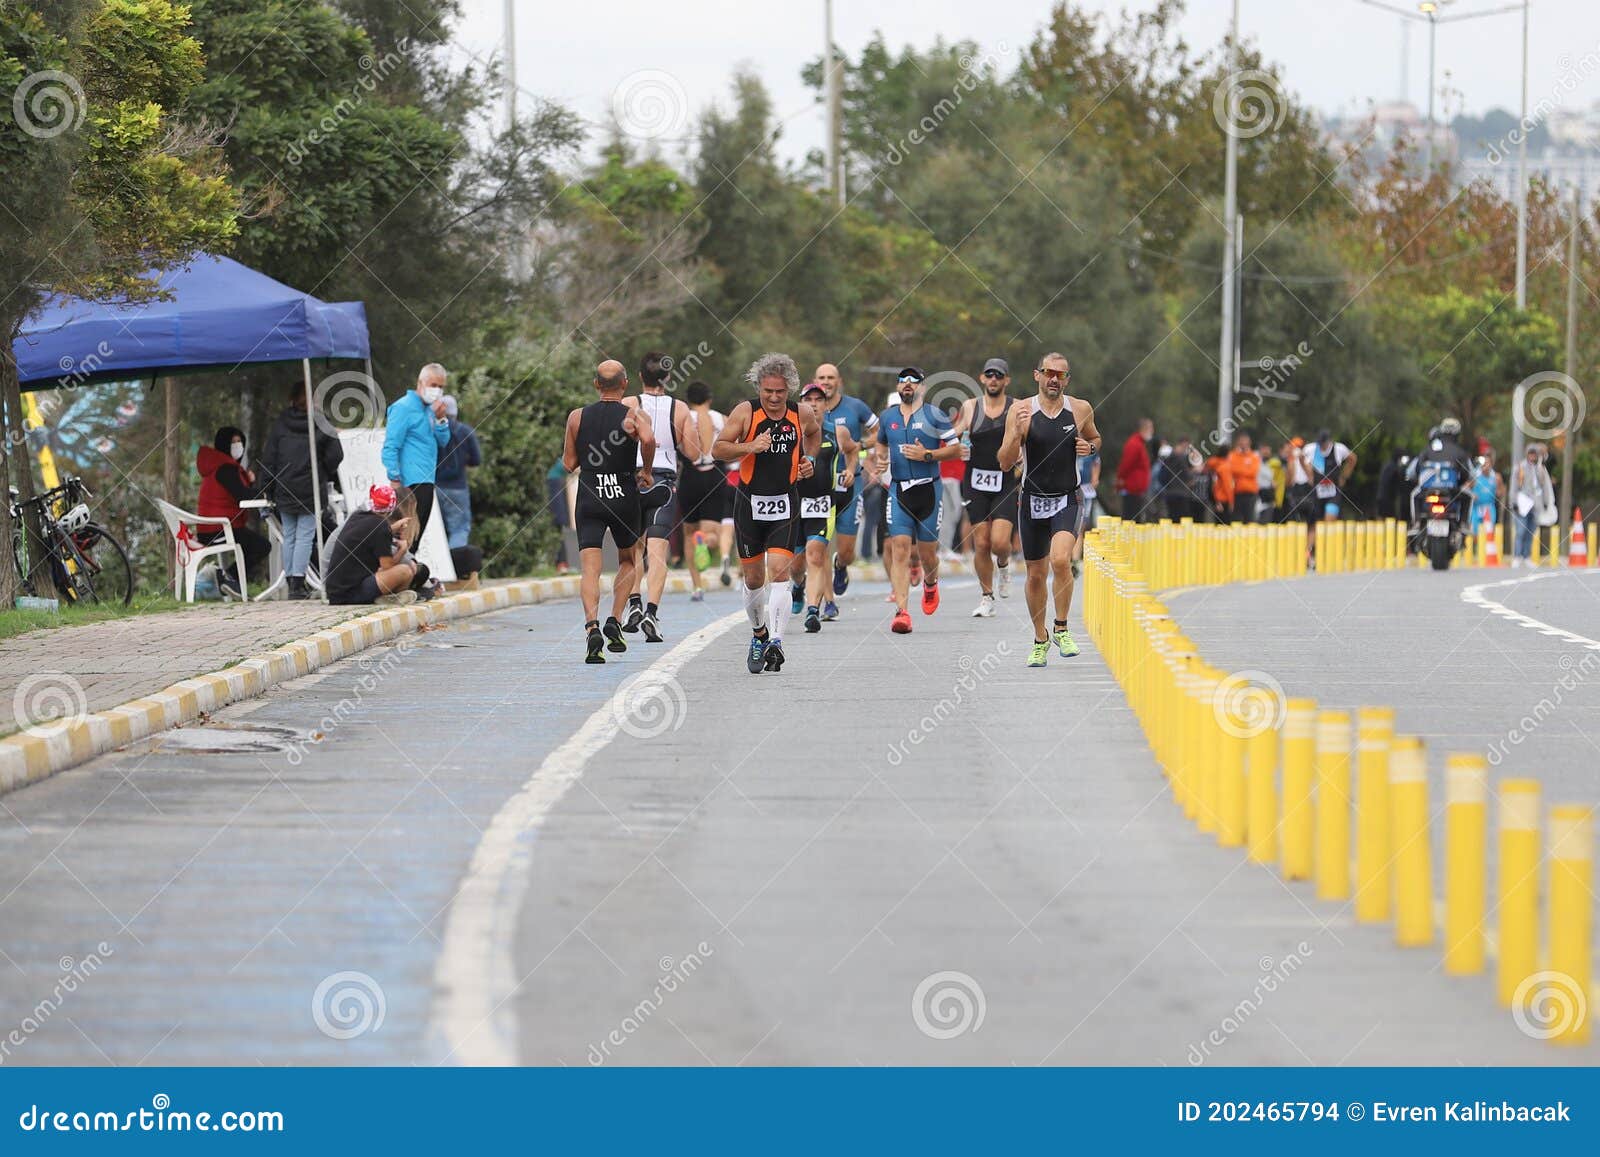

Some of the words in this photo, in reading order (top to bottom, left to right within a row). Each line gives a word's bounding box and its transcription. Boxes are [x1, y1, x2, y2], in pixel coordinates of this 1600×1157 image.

[596, 473, 618, 486] TAN
[976, 473, 998, 486] 241
[595, 485, 625, 499] TUR
[757, 500, 787, 515] 229
[806, 500, 829, 513] 263
